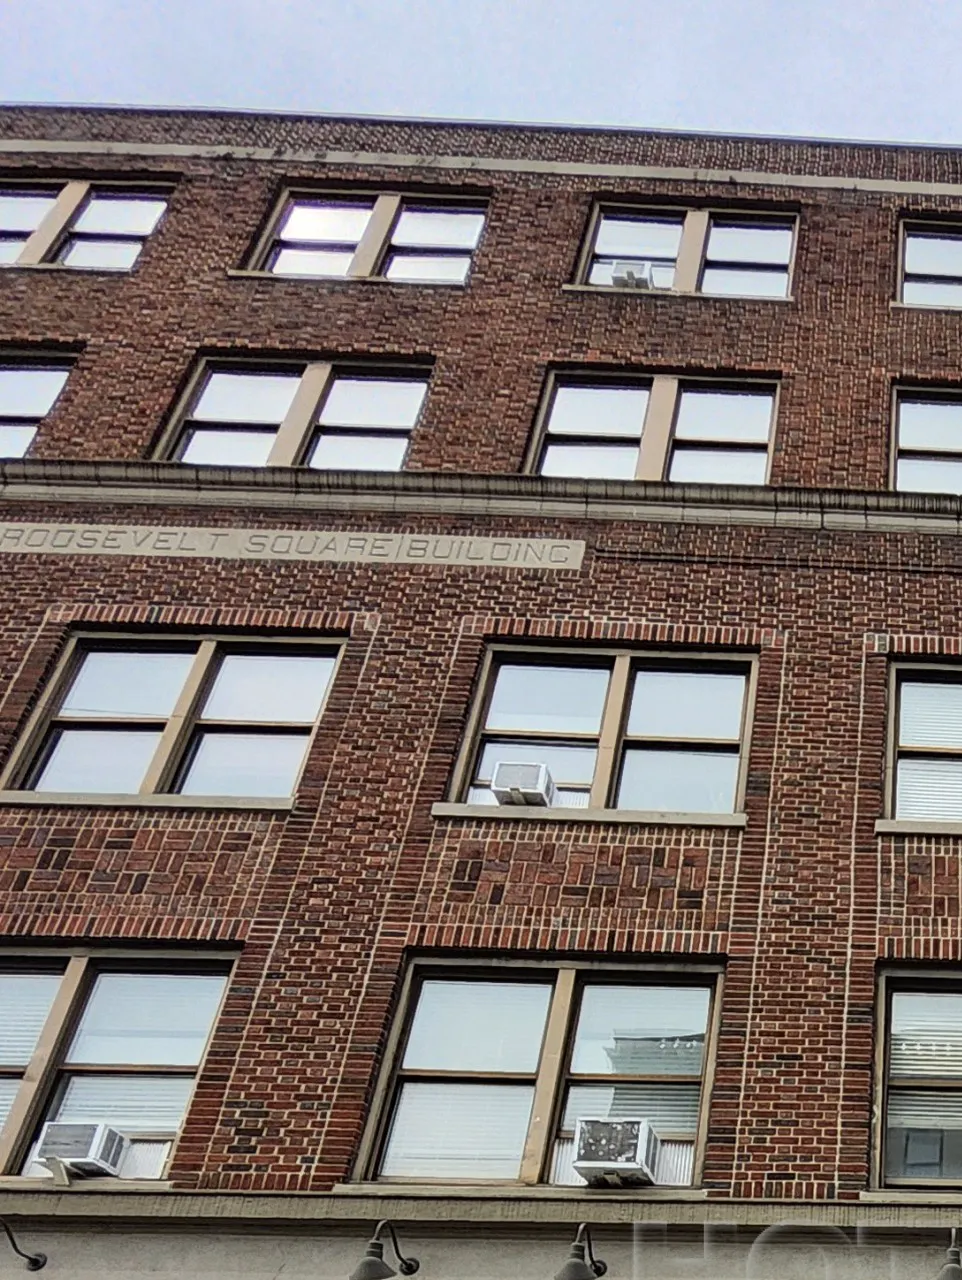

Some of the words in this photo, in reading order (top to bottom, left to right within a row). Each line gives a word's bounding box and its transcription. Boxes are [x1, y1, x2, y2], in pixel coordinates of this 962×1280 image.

[0, 528, 229, 551] ROOSEVELT
[244, 534, 394, 558] SQUARE
[405, 539, 571, 564] BUILDING
